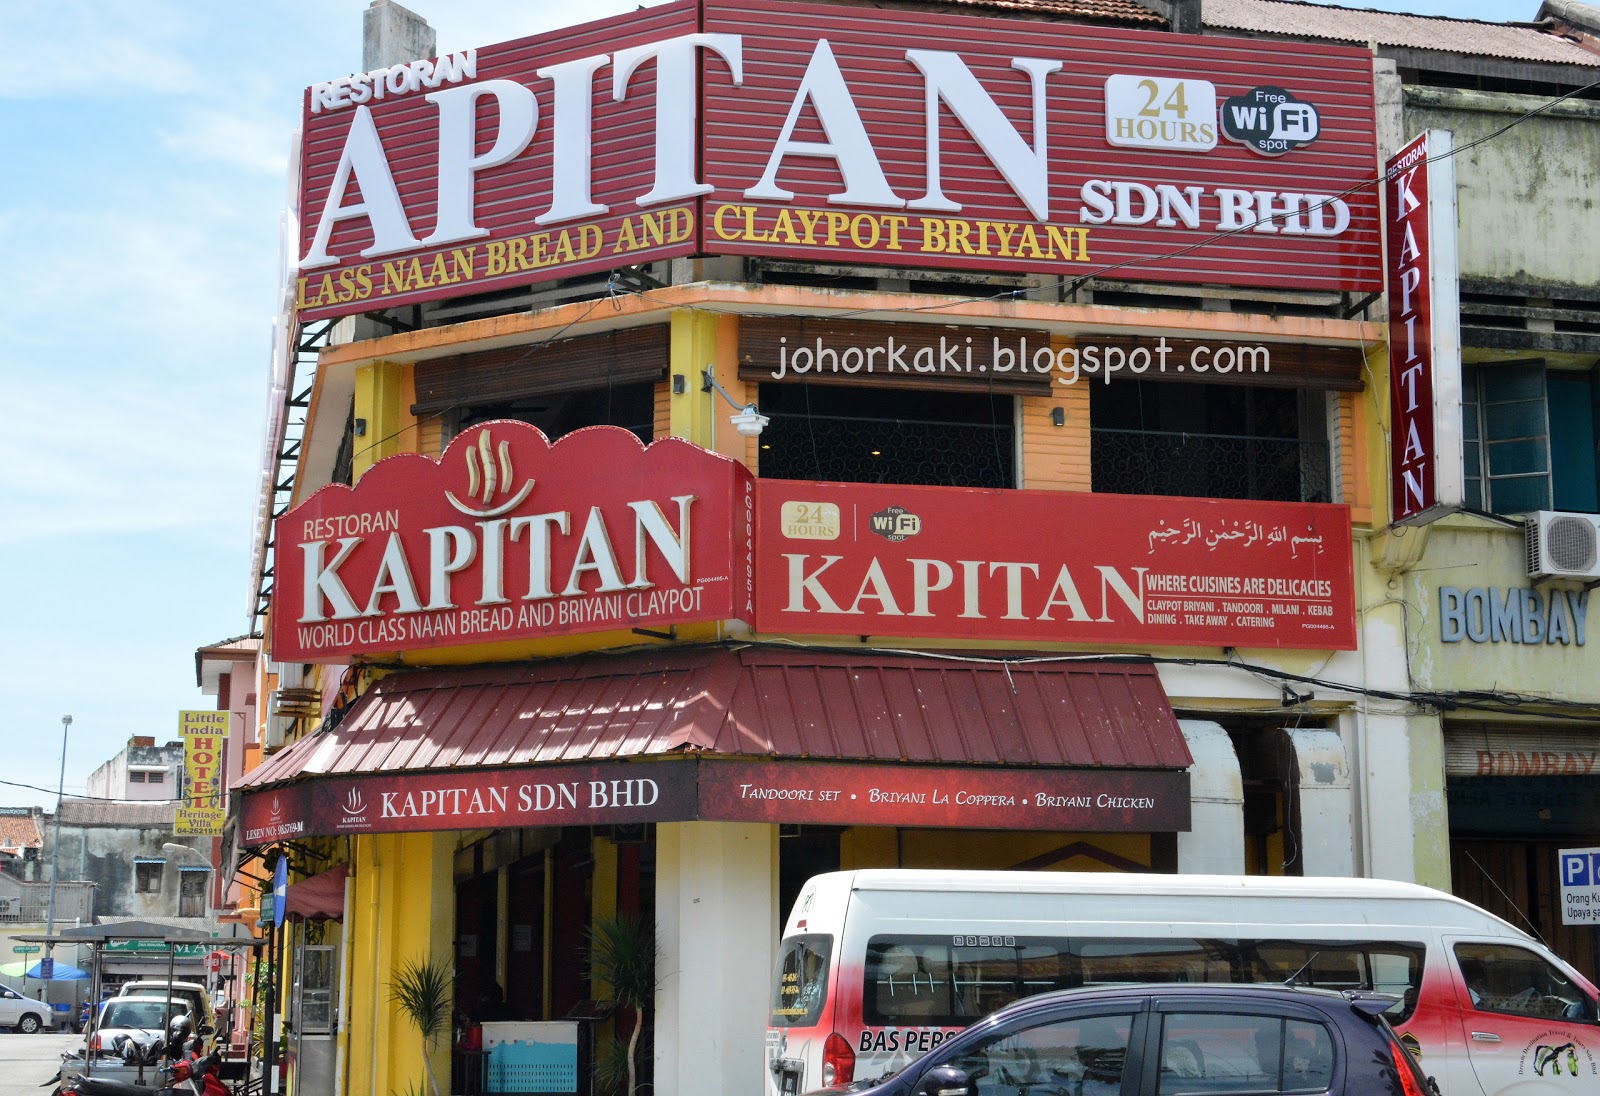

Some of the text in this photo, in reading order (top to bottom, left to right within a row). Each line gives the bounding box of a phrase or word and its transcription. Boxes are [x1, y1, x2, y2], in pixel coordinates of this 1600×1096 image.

[310, 48, 477, 113] RESTORAN
[1137, 79, 1189, 119] 24
[1255, 91, 1287, 104] Free
[1114, 117, 1214, 144] HOURS
[1258, 138, 1289, 152] spot
[1387, 140, 1427, 181] RESTORAN
[1080, 179, 1351, 237] SDN BHD
[381, 246, 476, 296] NAAN
[485, 224, 603, 278] BREAD
[613, 206, 694, 254] AND
[713, 203, 908, 251] CLAYPOT
[919, 217, 1092, 263] BRIYANI
[1394, 165, 1424, 515] KAPITAN
[303, 509, 399, 541] RESTORAN
[796, 504, 824, 524] 24
[788, 524, 835, 537] HOURS
[296, 495, 699, 624] KAPITAN
[781, 553, 1149, 625] KAPITAN
[1146, 574, 1332, 597] WHERE CUISINES ARE DELICACIES
[298, 586, 704, 650] WORLD CLASS NAAN BREAD AND BRIYANI CLAYPOT
[1147, 600, 1334, 616] CLAYPOT BRIYANI TANDOORI MILANI KEBAB
[1147, 614, 1275, 628] DINING TAKE AWAY CATERING
[1438, 586, 1590, 647] BOMBAY
[183, 724, 224, 735] India
[184, 712, 225, 723] Little
[192, 737, 214, 809] HOTEL
[1476, 750, 1597, 776] BOMBAY
[380, 777, 660, 819] KAPITAN SDN BHD
[179, 810, 222, 820] Heritage
[188, 819, 212, 828] Villa
[246, 828, 265, 840] LESEN
[1567, 857, 1585, 883] P
[1567, 893, 1590, 906] Orang
[1567, 907, 1591, 920] Upaya
[859, 1030, 900, 1052] BAS
